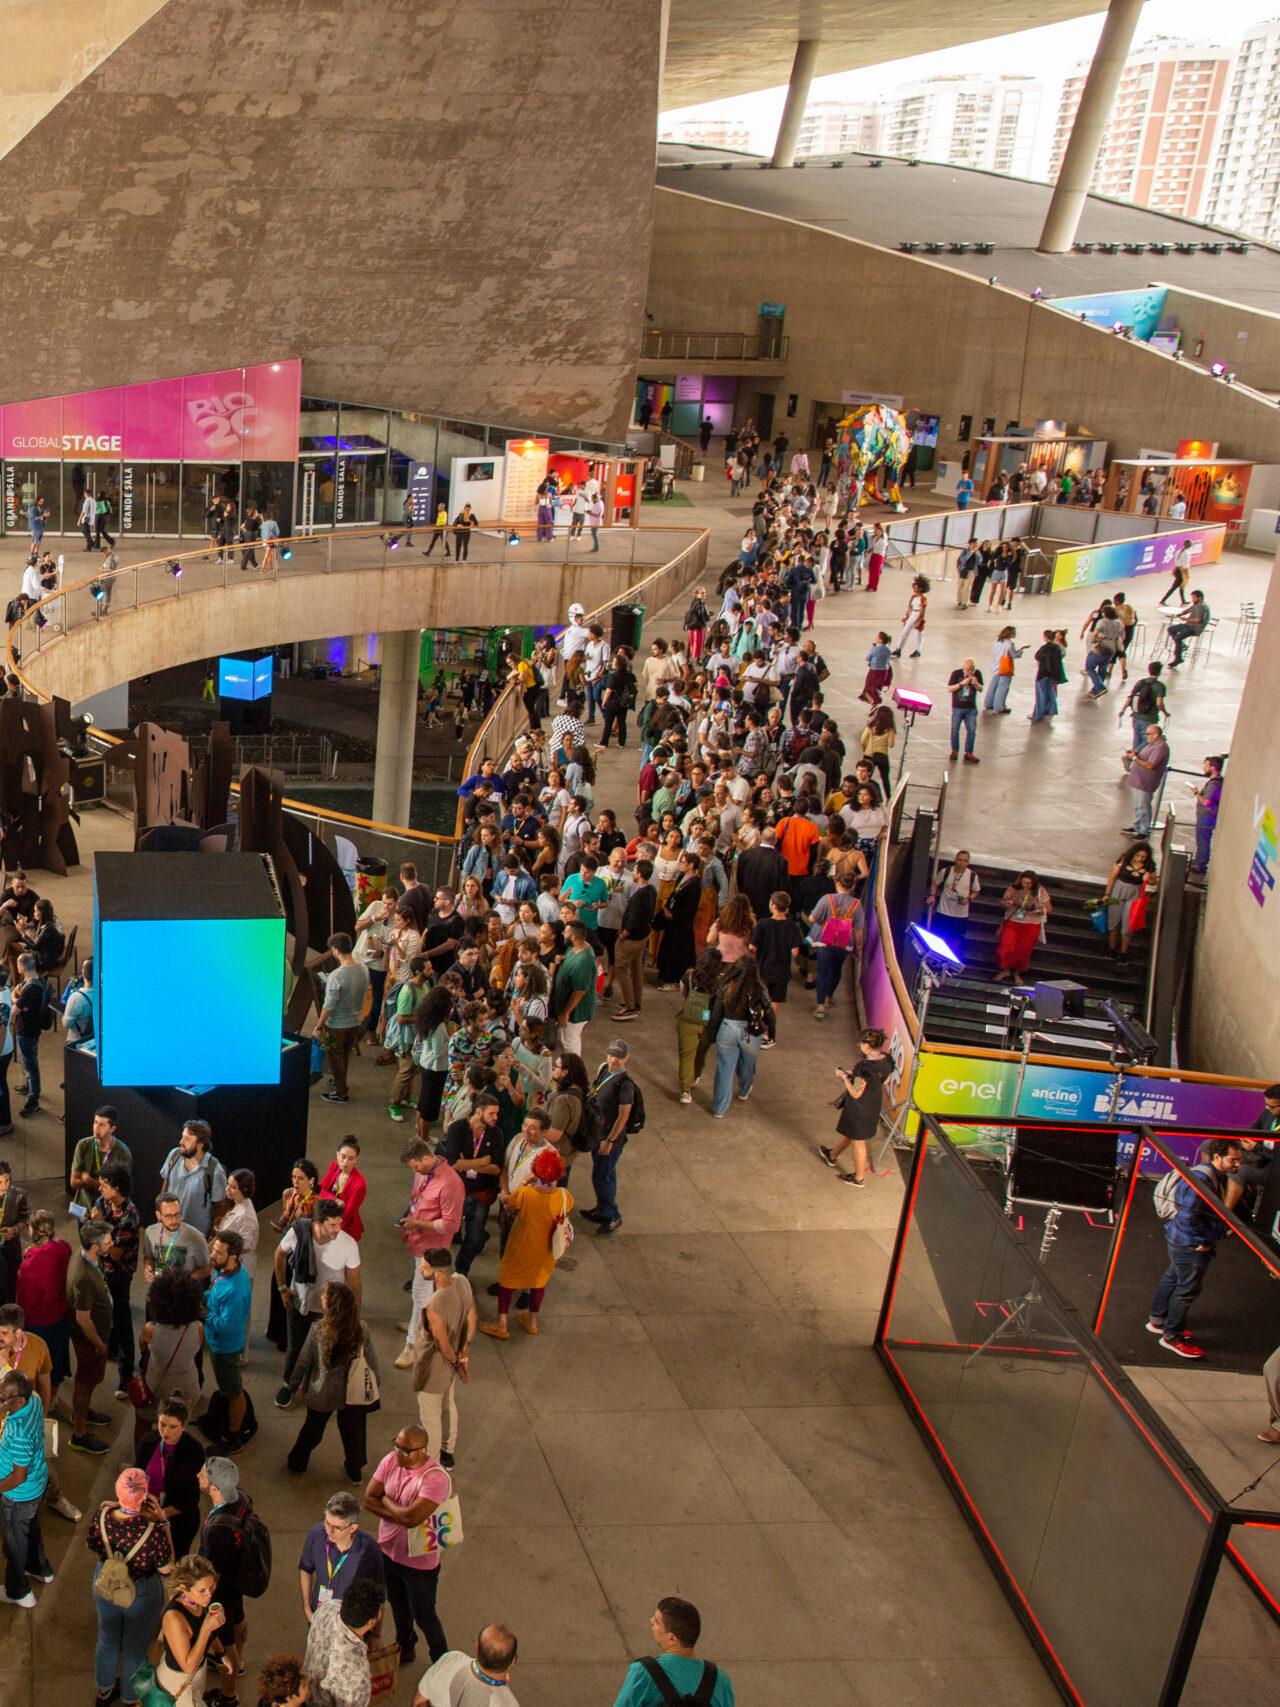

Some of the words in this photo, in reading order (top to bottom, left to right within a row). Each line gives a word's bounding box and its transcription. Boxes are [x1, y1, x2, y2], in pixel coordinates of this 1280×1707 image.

[12, 436, 61, 449] GLOBAL
[62, 435, 121, 451] STAGE
[6, 466, 15, 489] SALA
[124, 467, 133, 490] SALA
[338, 460, 346, 482] SALA
[6, 491, 15, 527] GRANDE
[124, 493, 133, 529] GRANDE
[336, 484, 345, 520] GRANDE
[939, 1079, 1004, 1101] enel
[1031, 1088, 1078, 1103] ancine
[1141, 1092, 1175, 1101] FEDERAL
[1093, 1094, 1178, 1121] BRASIL
